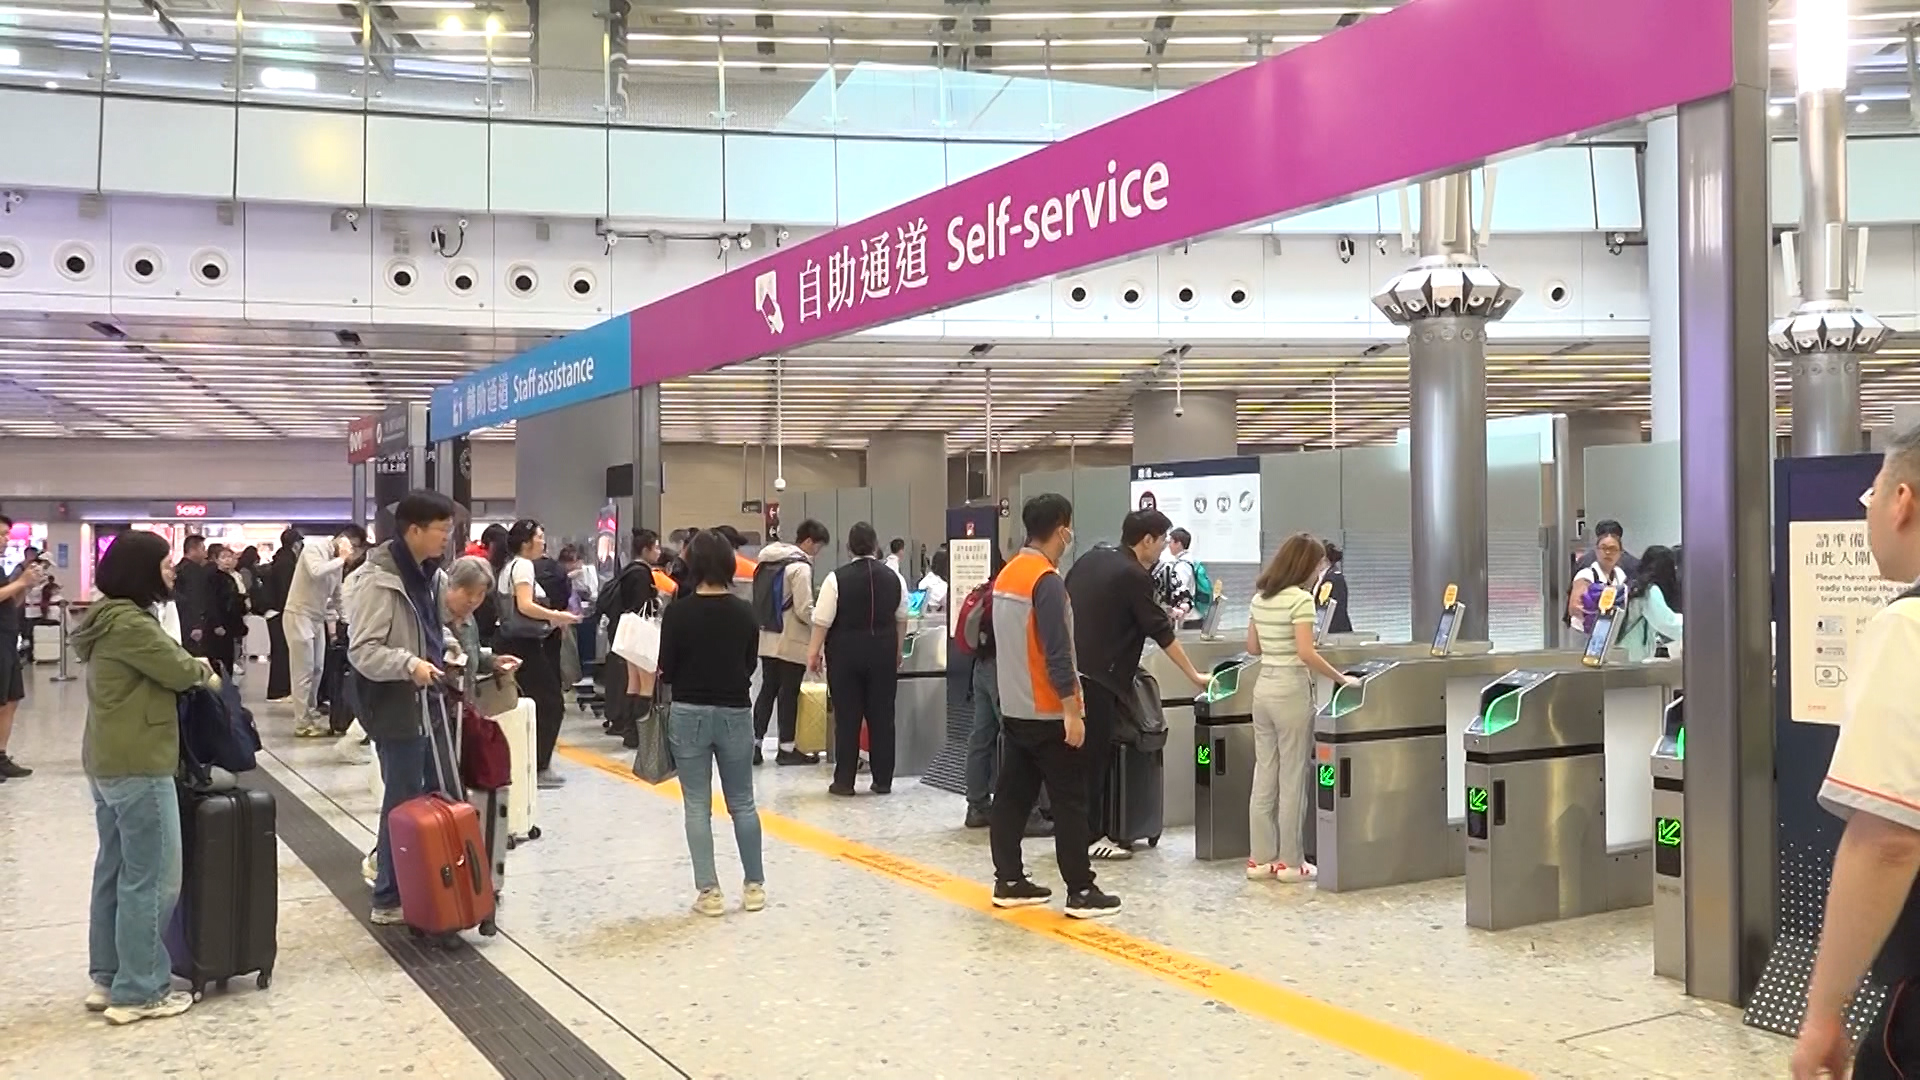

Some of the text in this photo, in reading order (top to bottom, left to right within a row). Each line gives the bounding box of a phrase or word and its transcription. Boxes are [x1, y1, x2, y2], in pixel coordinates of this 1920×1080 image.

[799, 160, 1170, 325] 自助通道 Self-service
[513, 367, 537, 404] Staff
[537, 356, 594, 393] assistance
[1815, 573, 1842, 581] Please
[1816, 583, 1841, 593] ready
[1842, 584, 1852, 592] to
